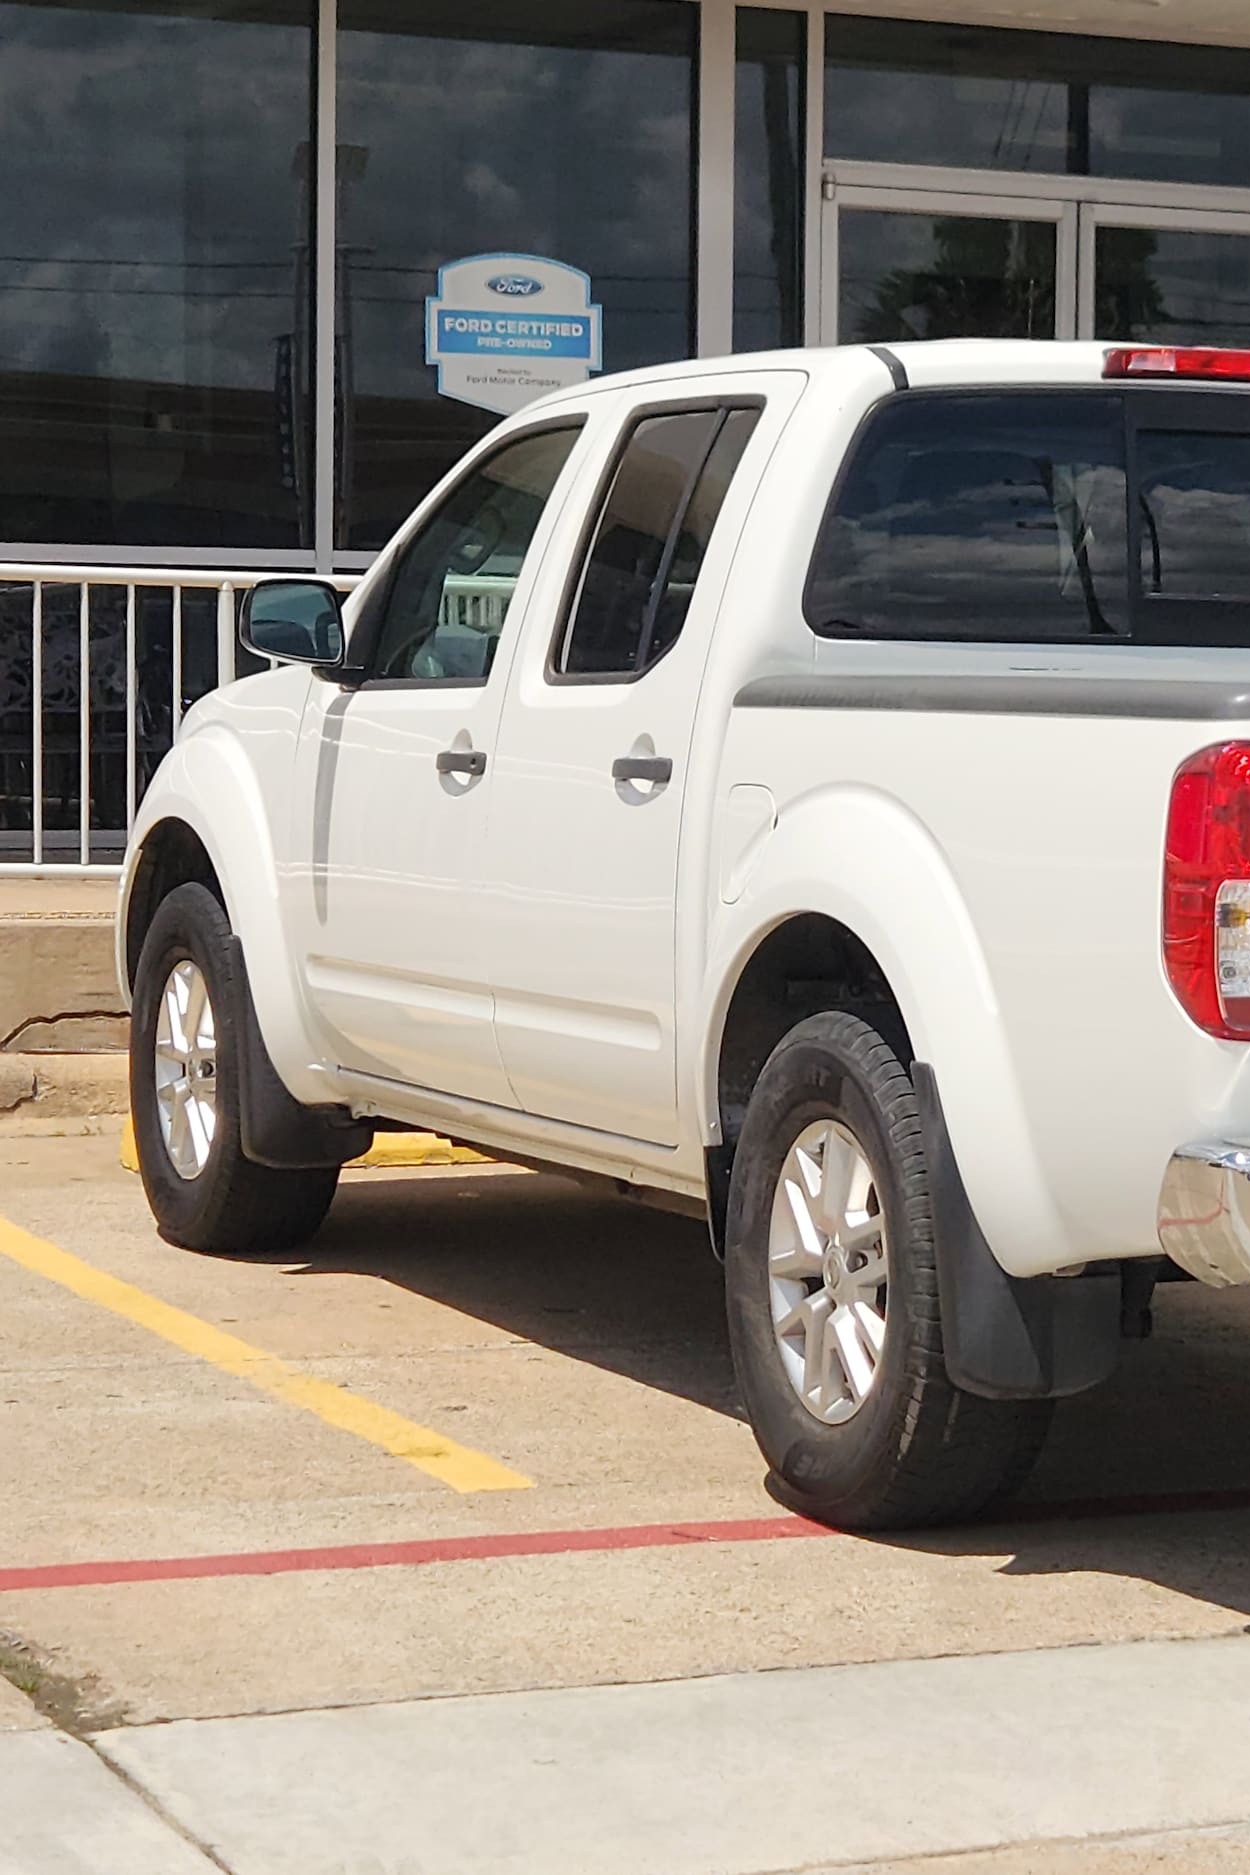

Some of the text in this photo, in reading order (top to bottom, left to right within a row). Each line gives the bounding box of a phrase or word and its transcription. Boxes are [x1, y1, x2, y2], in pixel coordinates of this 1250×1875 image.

[496, 277, 532, 295] Ford
[445, 317, 584, 337] FORD CERTIFIED
[477, 337, 552, 350] PRE-OWNED
